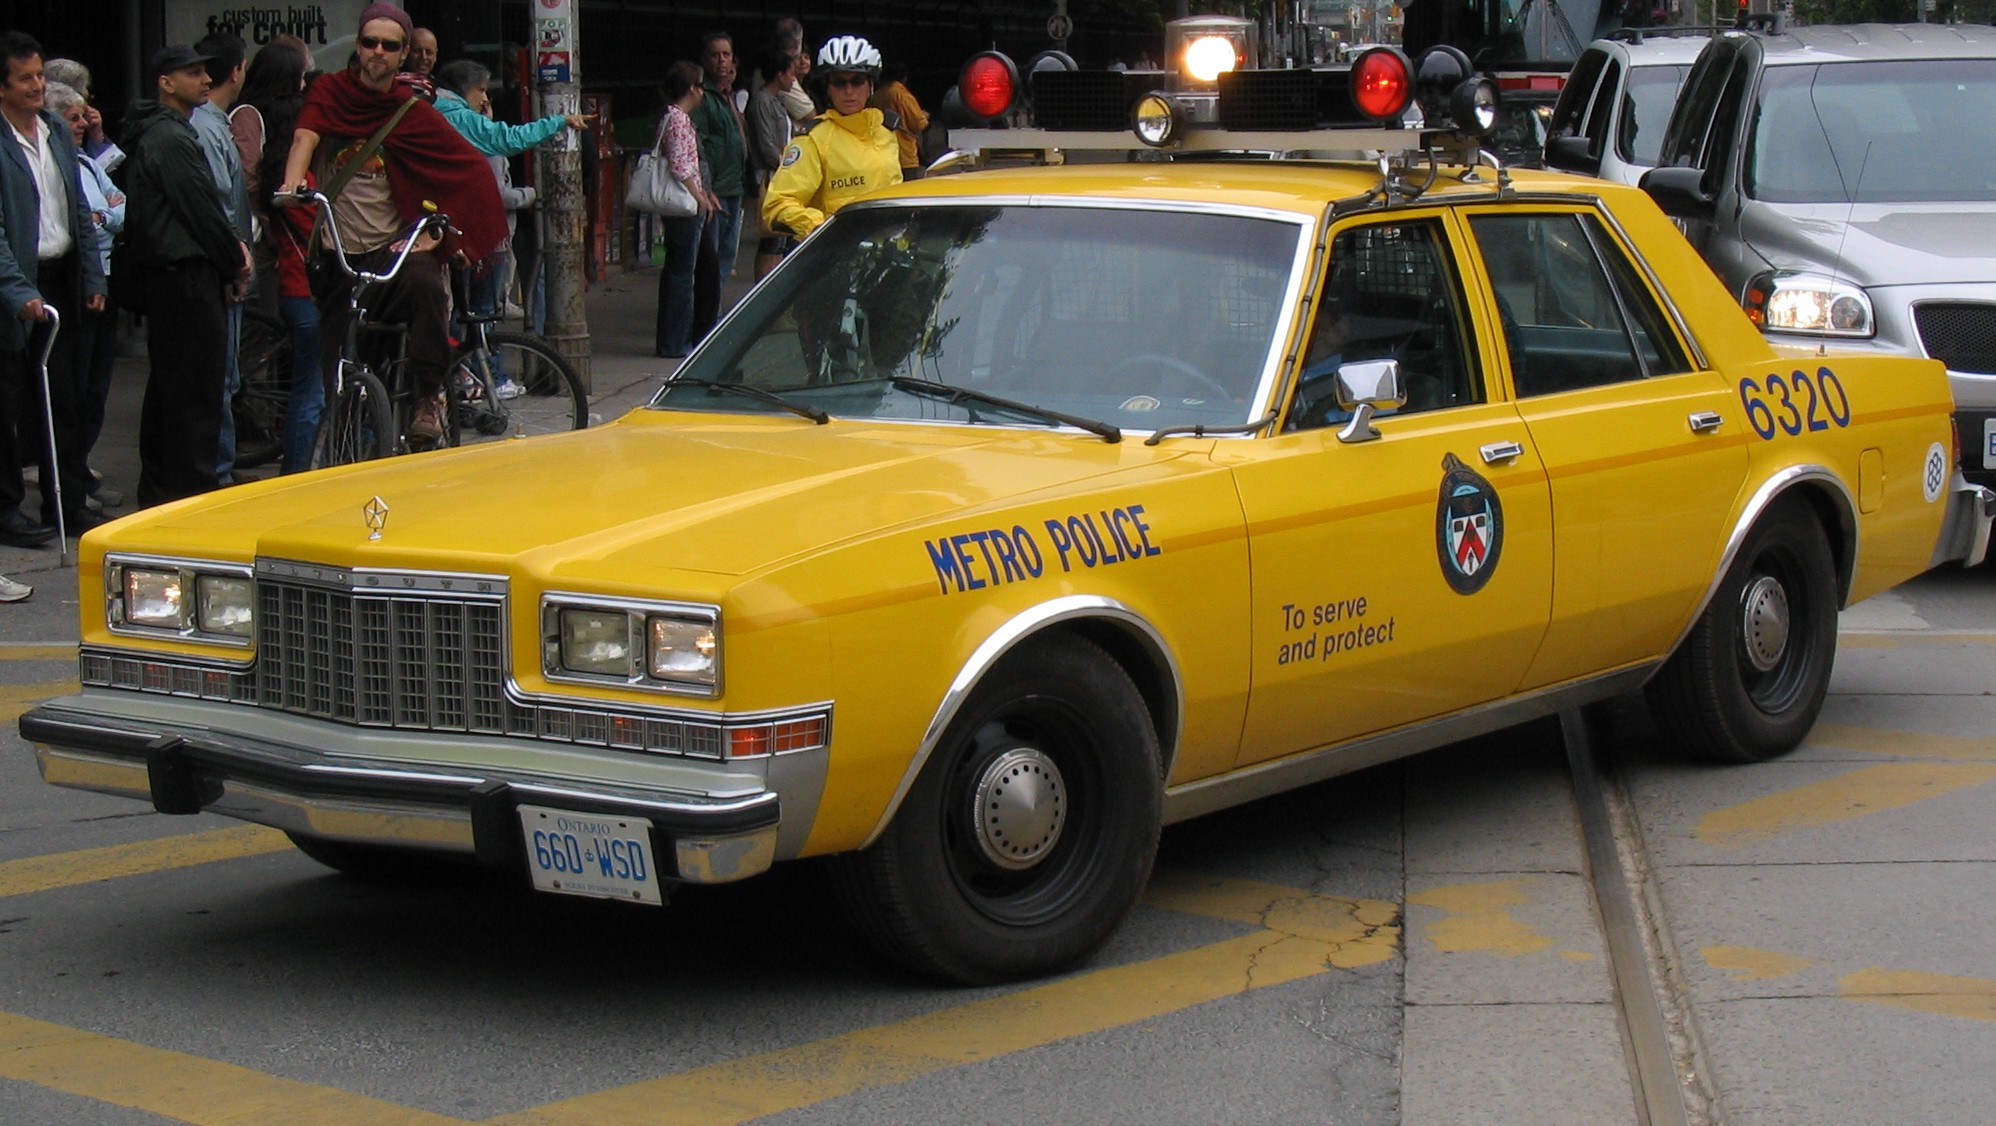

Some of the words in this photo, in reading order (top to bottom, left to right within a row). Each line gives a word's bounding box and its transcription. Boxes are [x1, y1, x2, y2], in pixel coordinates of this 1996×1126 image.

[223, 6, 281, 23] custom
[287, 5, 323, 24] built
[253, 16, 328, 45] court
[830, 175, 865, 189] POLICE
[1739, 366, 1850, 441] 6320
[924, 525, 1043, 595] METRO
[1044, 504, 1161, 572] POLICE
[1282, 604, 1305, 631] To
[1313, 597, 1367, 626] serve
[1278, 632, 1317, 665] and
[1322, 616, 1395, 661] protect
